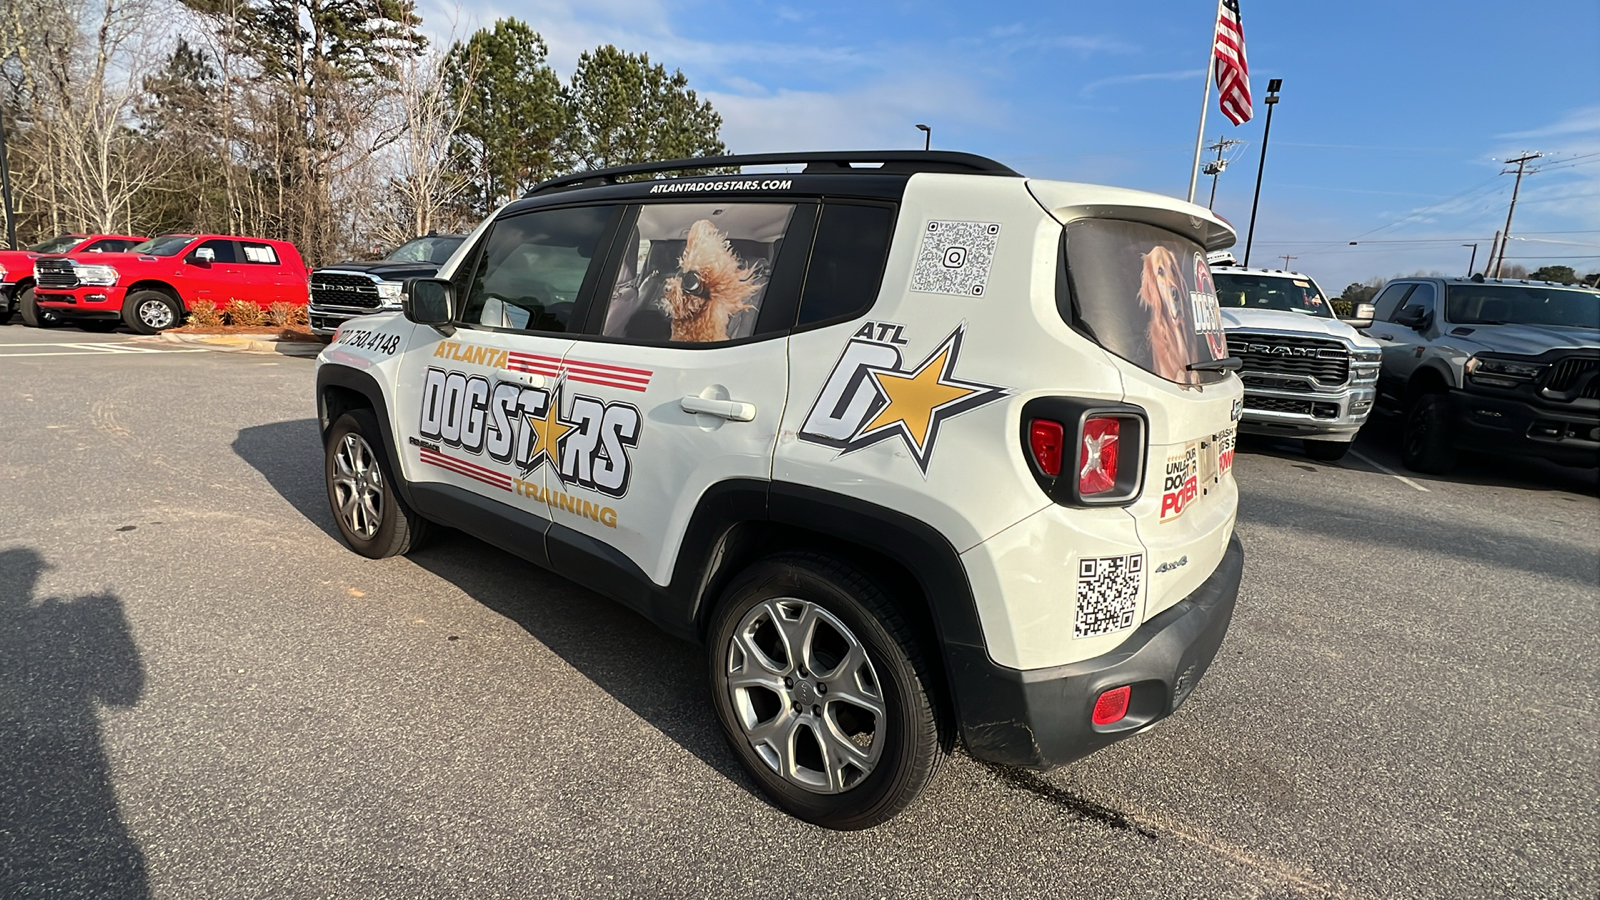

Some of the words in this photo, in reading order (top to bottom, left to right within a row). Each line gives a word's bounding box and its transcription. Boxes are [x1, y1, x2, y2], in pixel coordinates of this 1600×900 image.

[649, 180, 792, 194] ATLANTADOGSTARS.COM
[853, 321, 909, 345] ATL
[433, 341, 508, 369] ATLANTA
[1248, 344, 1317, 358] RAM
[512, 477, 618, 529] TRAINING
